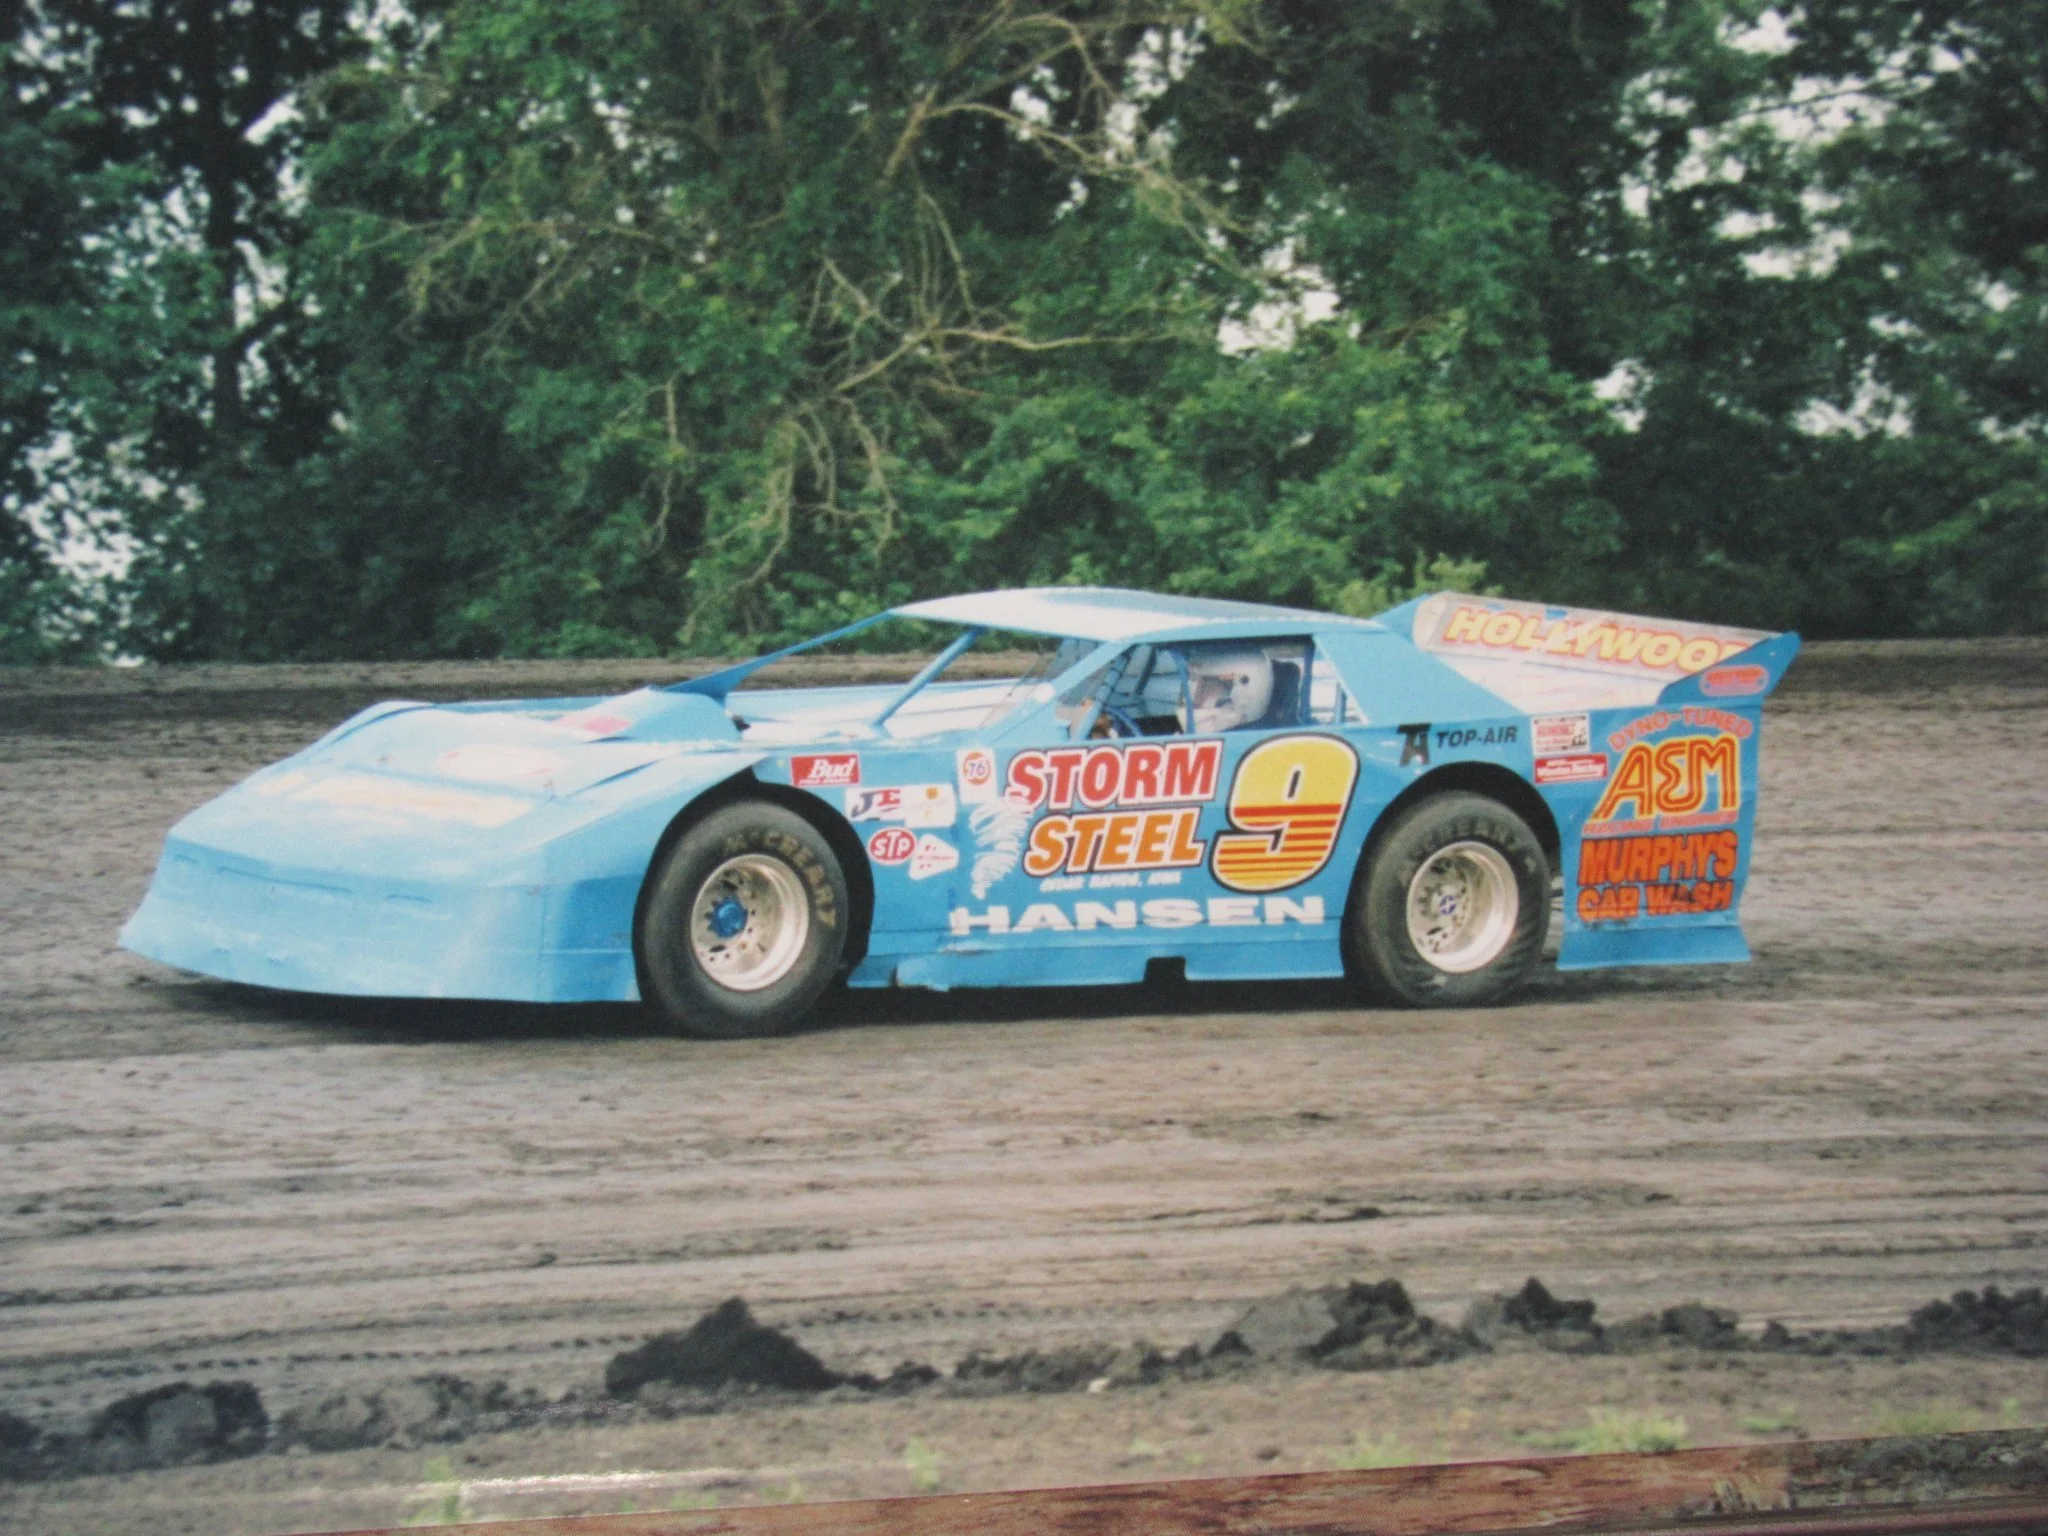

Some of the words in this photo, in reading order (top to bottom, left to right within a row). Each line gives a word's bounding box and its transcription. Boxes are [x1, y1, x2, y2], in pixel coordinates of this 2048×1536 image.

[1436, 725, 1518, 748] TOP-AIR
[1608, 705, 1753, 751] DYNO-TUNED
[808, 757, 856, 778] Bud
[967, 761, 986, 778] 76
[1006, 739, 1225, 812] STORM
[1209, 732, 1360, 894] 9
[874, 831, 911, 858] STP
[1022, 805, 1207, 877] STEEL
[950, 896, 1324, 936] HANSEN
[1577, 887, 1640, 922] CAR
[1645, 879, 1734, 916] WASH
